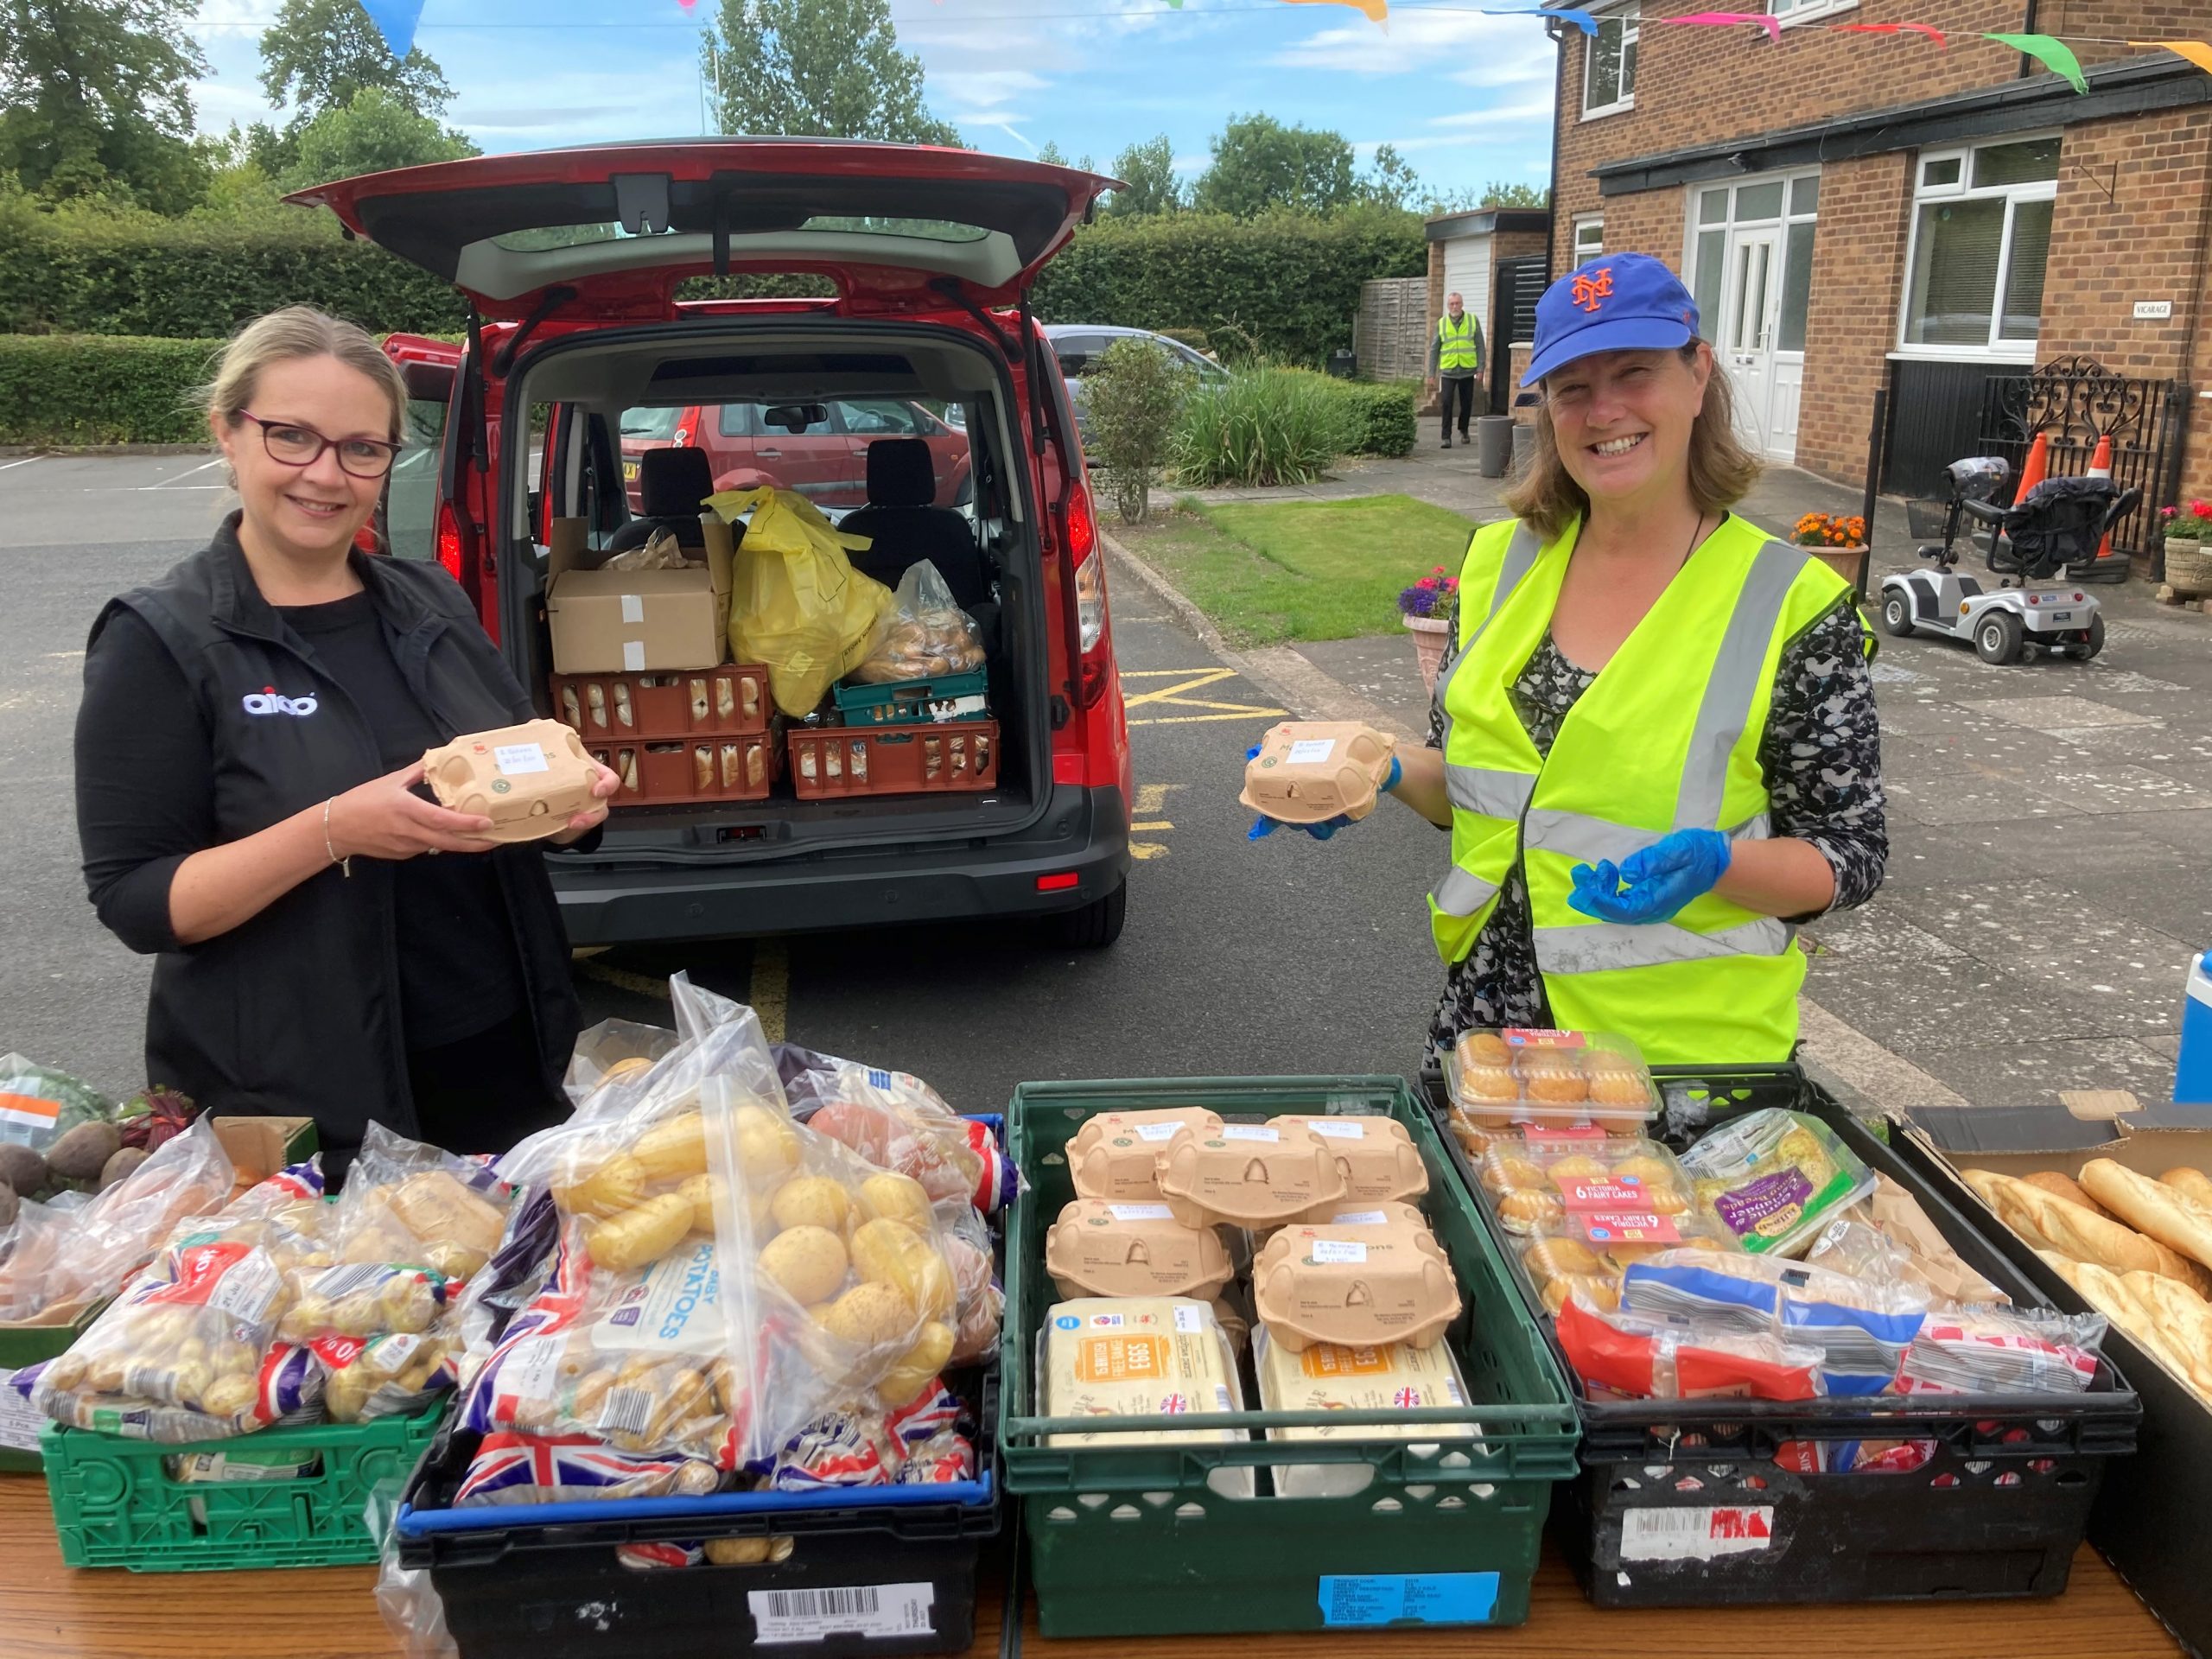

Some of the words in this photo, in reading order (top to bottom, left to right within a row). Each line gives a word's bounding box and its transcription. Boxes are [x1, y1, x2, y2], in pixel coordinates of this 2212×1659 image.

[2137, 305, 2167, 314] VICARAGE
[1575, 1185, 1587, 1199] 6
[1588, 1191, 1611, 1199] FAIRY
[1612, 1190, 1638, 1199] CAKES
[1722, 1192, 1770, 1211] Breads
[1729, 1177, 1798, 1219] Coriander
[1748, 1192, 1791, 1220] Garlic
[1646, 1215, 1659, 1228] 6
[223, 1298, 231, 1307] 21
[232, 1282, 242, 1295] Jul
[658, 1244, 714, 1339] POTATOES
[702, 1269, 719, 1304] BABY
[1093, 1342, 1109, 1367] BRITISH
[1110, 1338, 1125, 1360] RANGE
[1127, 1343, 1151, 1370] EGGS
[1110, 1360, 1126, 1376] FREE
[911, 1599, 919, 1628] THURSDAY
